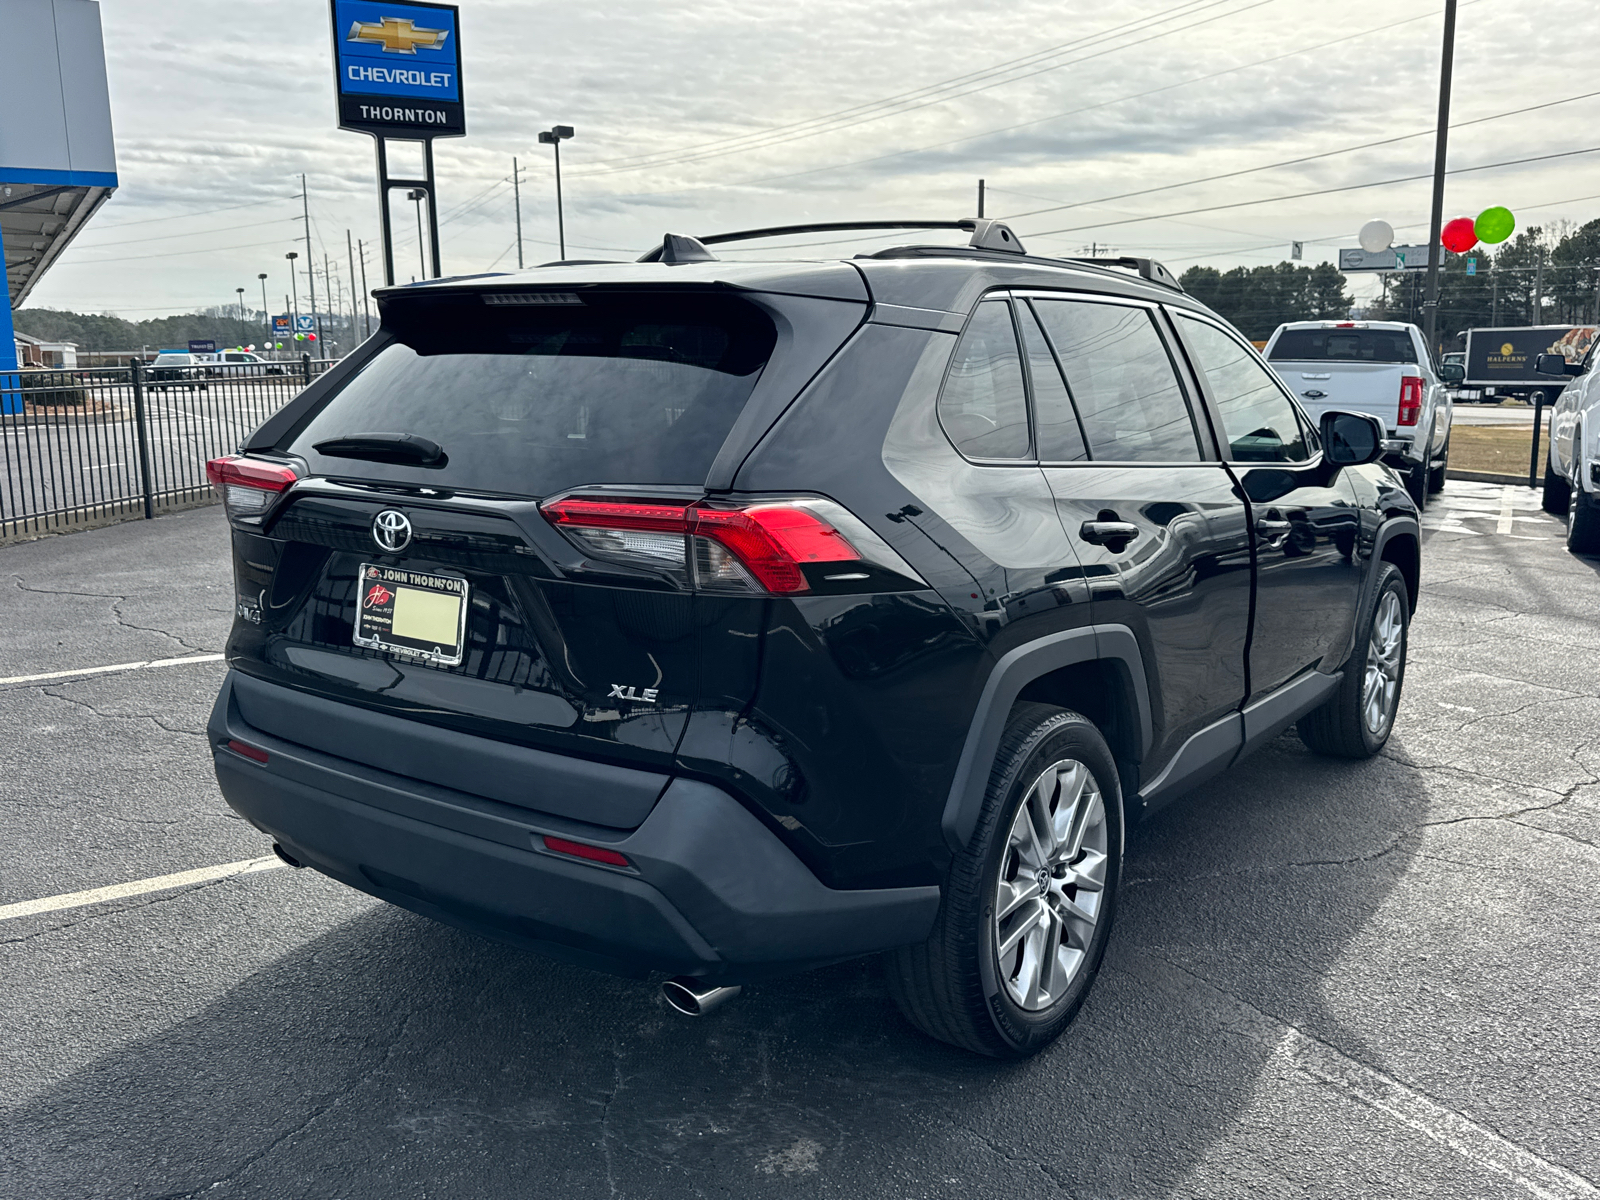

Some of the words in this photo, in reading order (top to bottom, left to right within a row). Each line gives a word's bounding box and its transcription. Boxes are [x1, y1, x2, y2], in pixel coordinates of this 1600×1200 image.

[348, 65, 451, 87] CHEVROLET
[360, 105, 447, 124] THORNTON
[383, 569, 408, 583] JOHN
[409, 574, 461, 592] THORNTON
[389, 646, 420, 657] CHEVROLET
[607, 683, 659, 703] XLE
